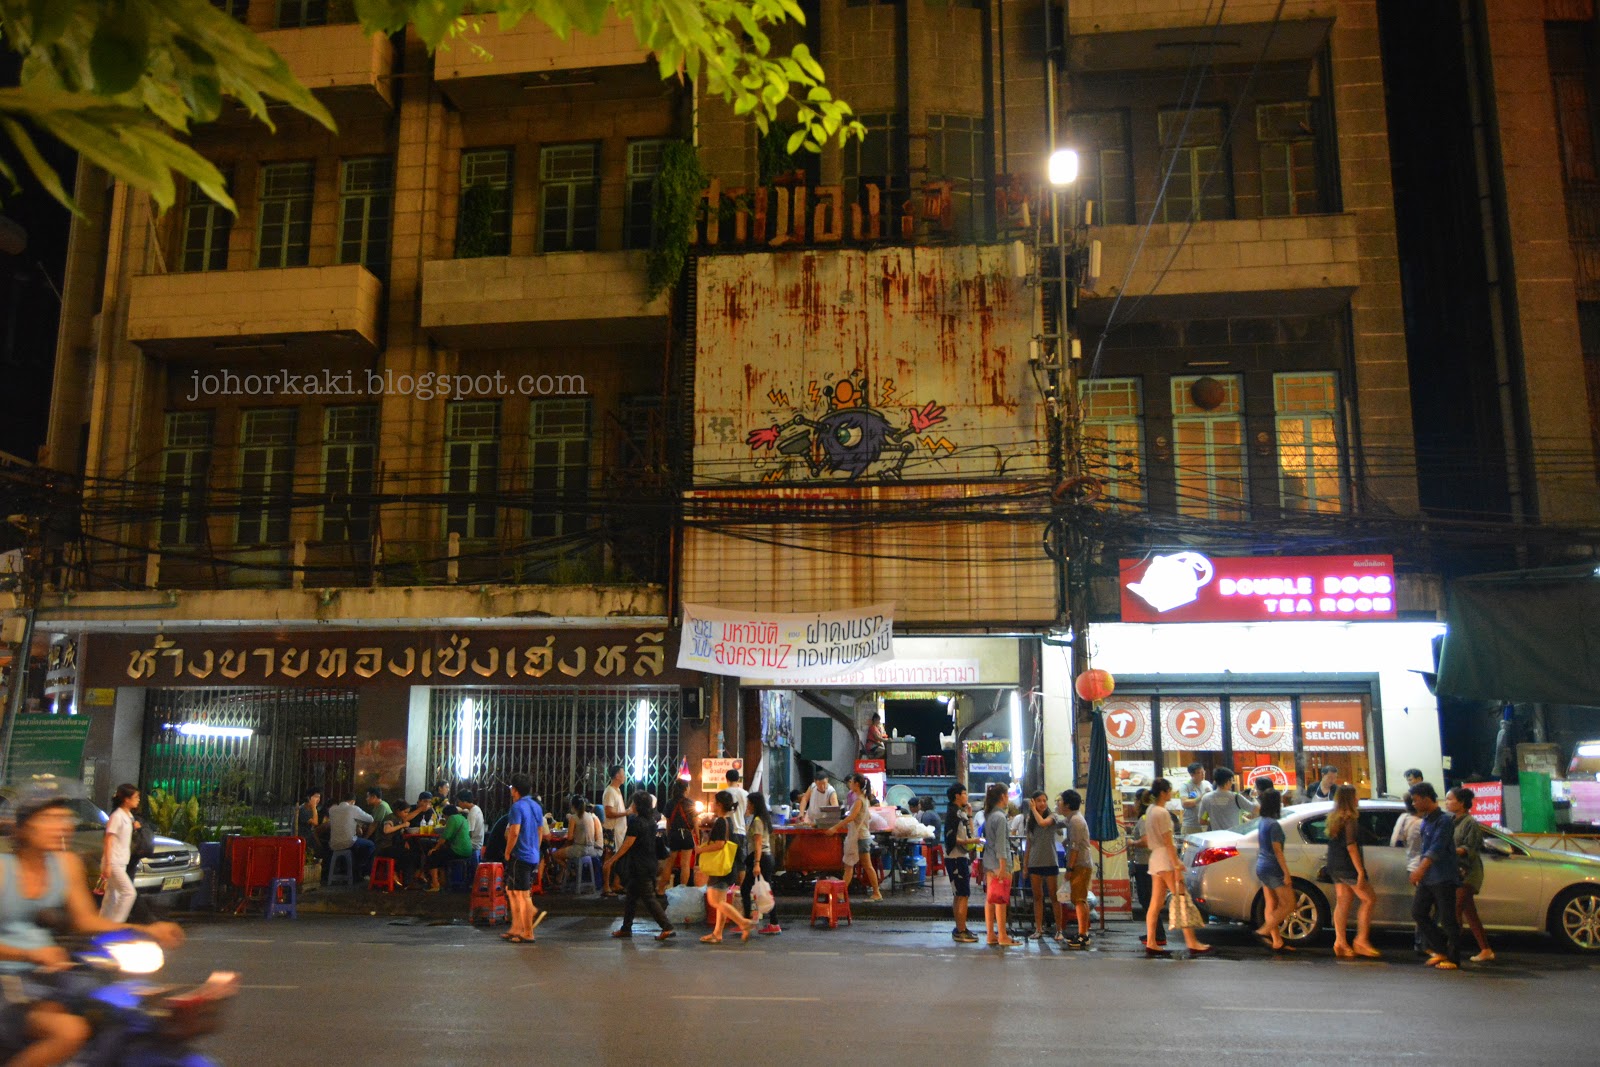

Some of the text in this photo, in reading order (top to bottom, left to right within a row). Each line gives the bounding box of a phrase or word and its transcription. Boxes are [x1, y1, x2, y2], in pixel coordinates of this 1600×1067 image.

[1218, 576, 1392, 596] DOUBLE DOGS
[1263, 597, 1392, 613] TEA ROOM
[1305, 720, 1345, 729] OF FINE
[1305, 731, 1359, 740] SELECTION
